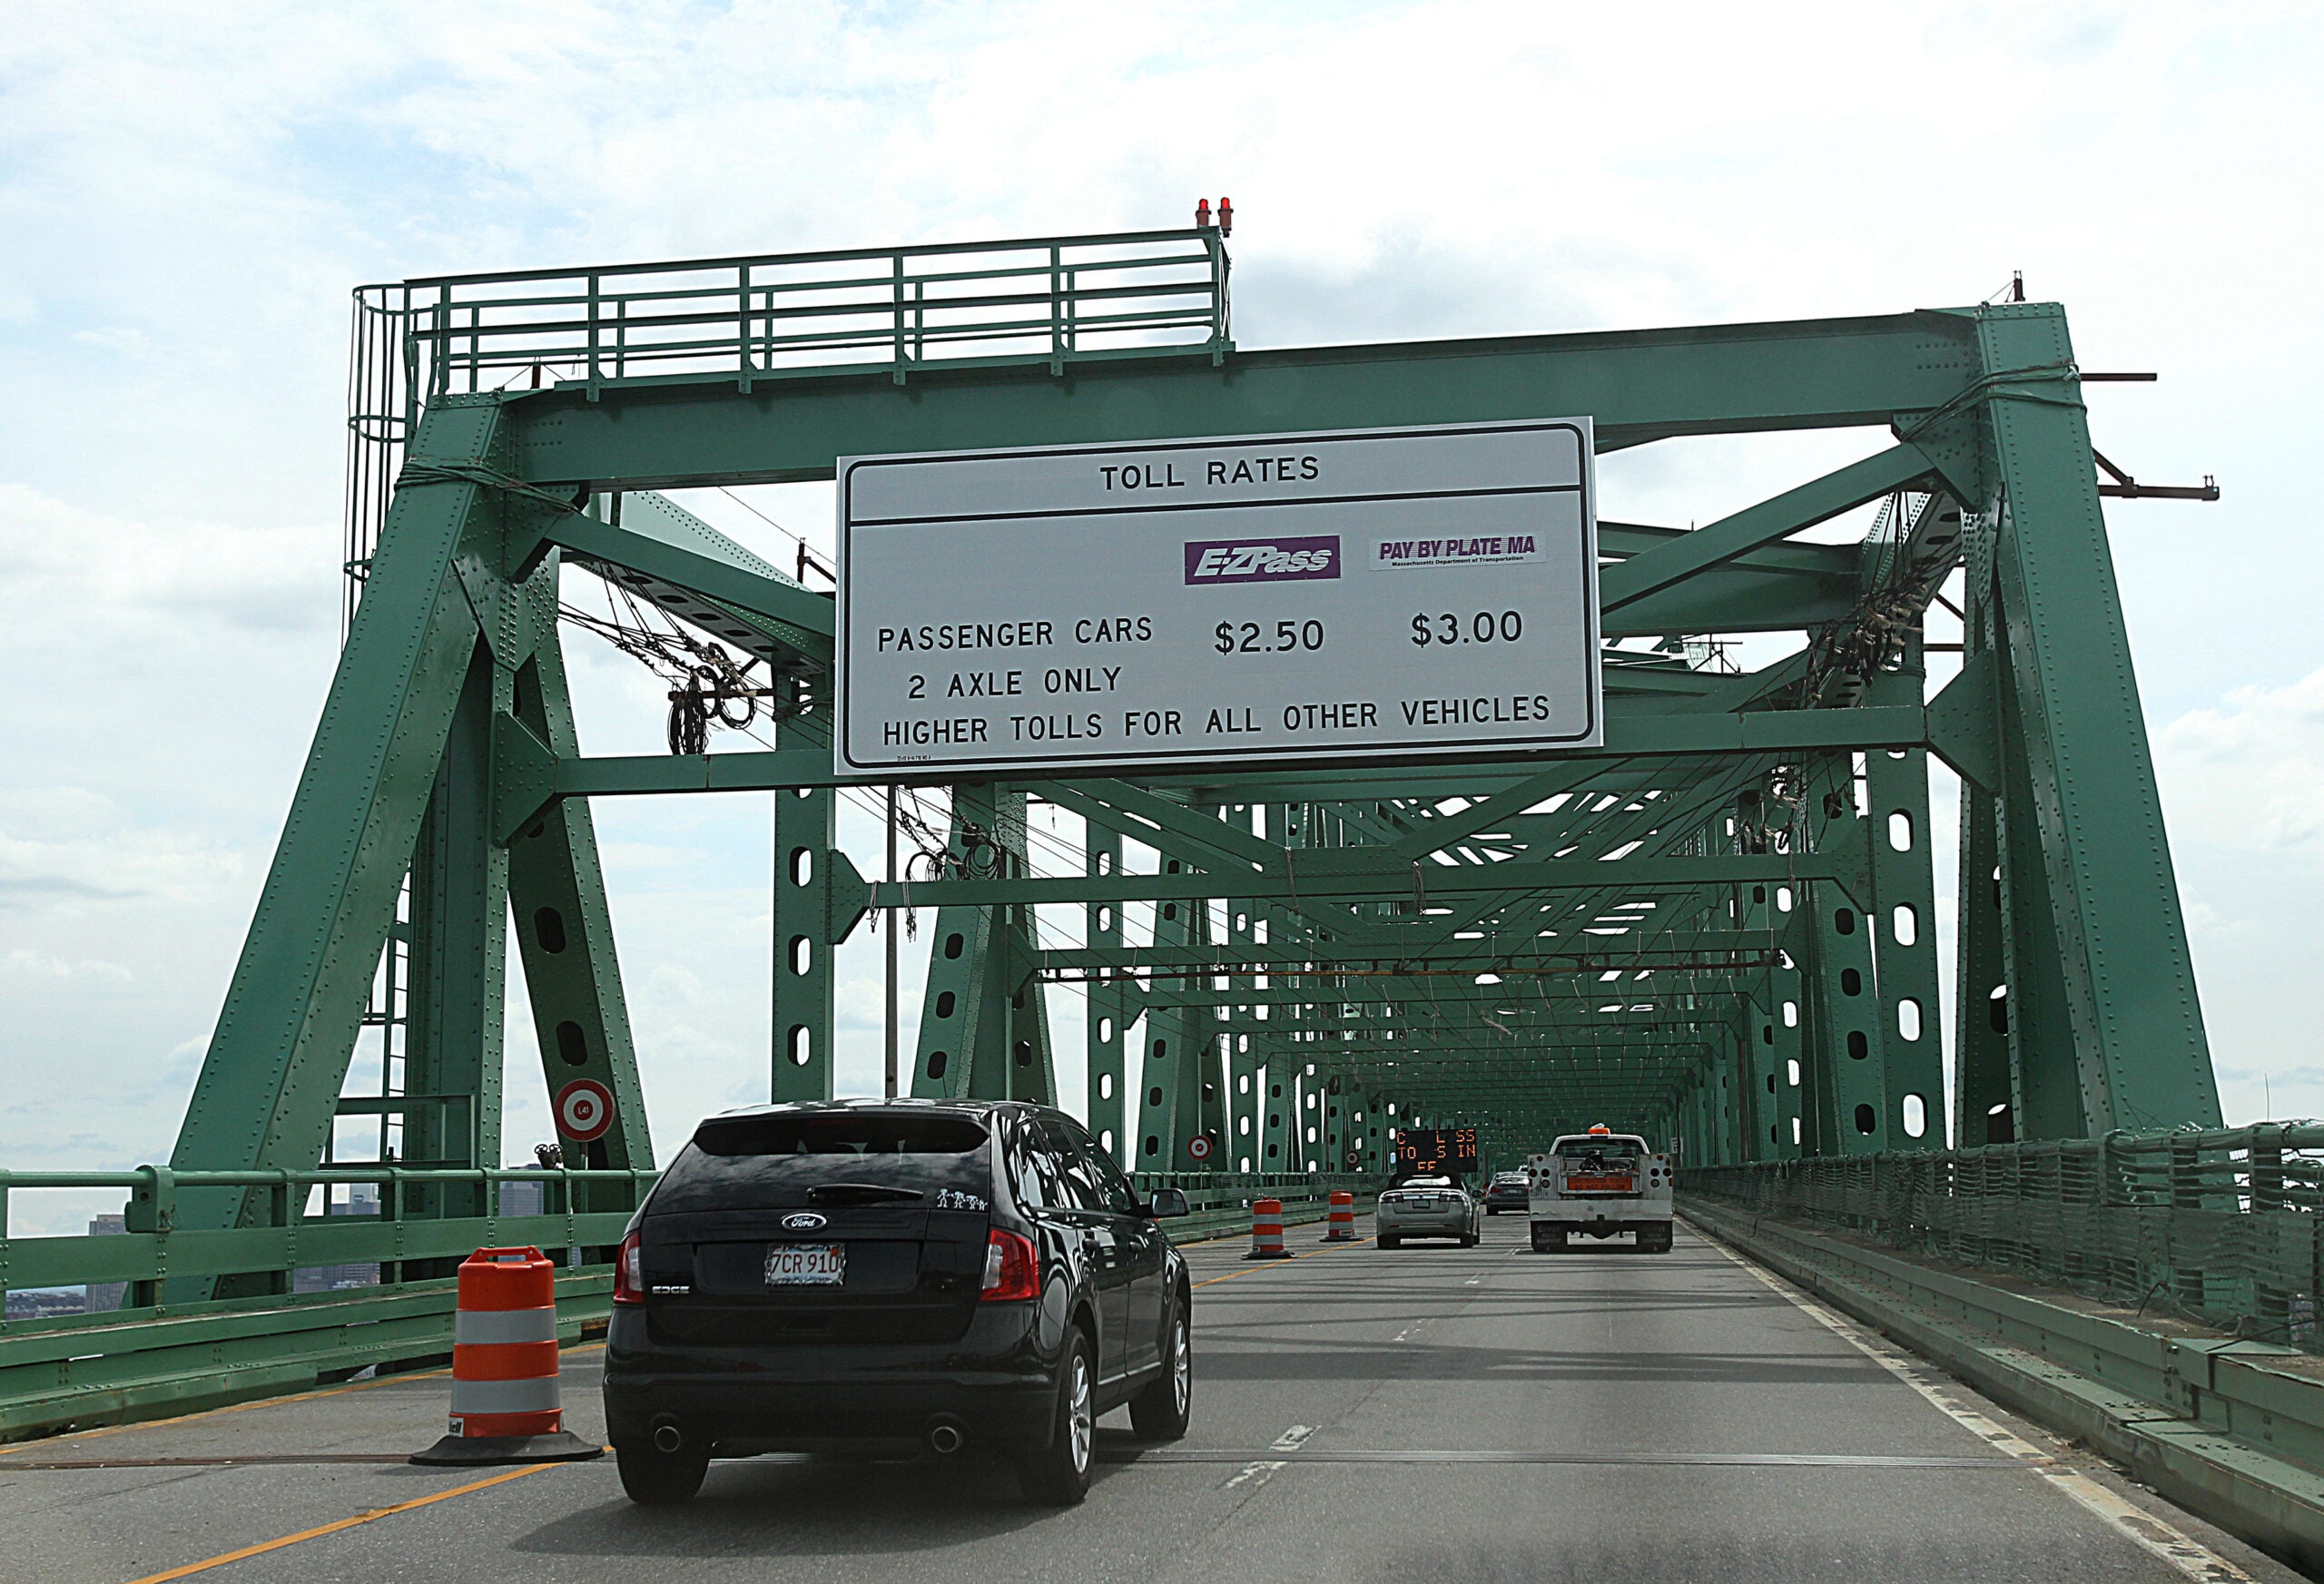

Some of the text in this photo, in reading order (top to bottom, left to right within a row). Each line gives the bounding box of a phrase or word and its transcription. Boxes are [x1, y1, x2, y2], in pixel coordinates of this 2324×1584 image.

[1100, 457, 1318, 489] TOLL RATES
[1380, 536, 1535, 560] PAY BY PLATE MA
[1392, 559, 1434, 567] Massachusetts
[1435, 557, 1472, 566] Department
[879, 617, 1151, 653] PASSENGER CARS
[1214, 619, 1324, 655] $2.50
[1412, 611, 1522, 648] $3.00
[909, 667, 1121, 699] 2 AXLE ONLY
[884, 695, 1550, 745] HIGHER TOLLS FOR ALL OTHER VEHICLES
[791, 1217, 816, 1227] Ford
[772, 1254, 839, 1274] 7CR 910
[653, 1285, 690, 1294] EDGE
